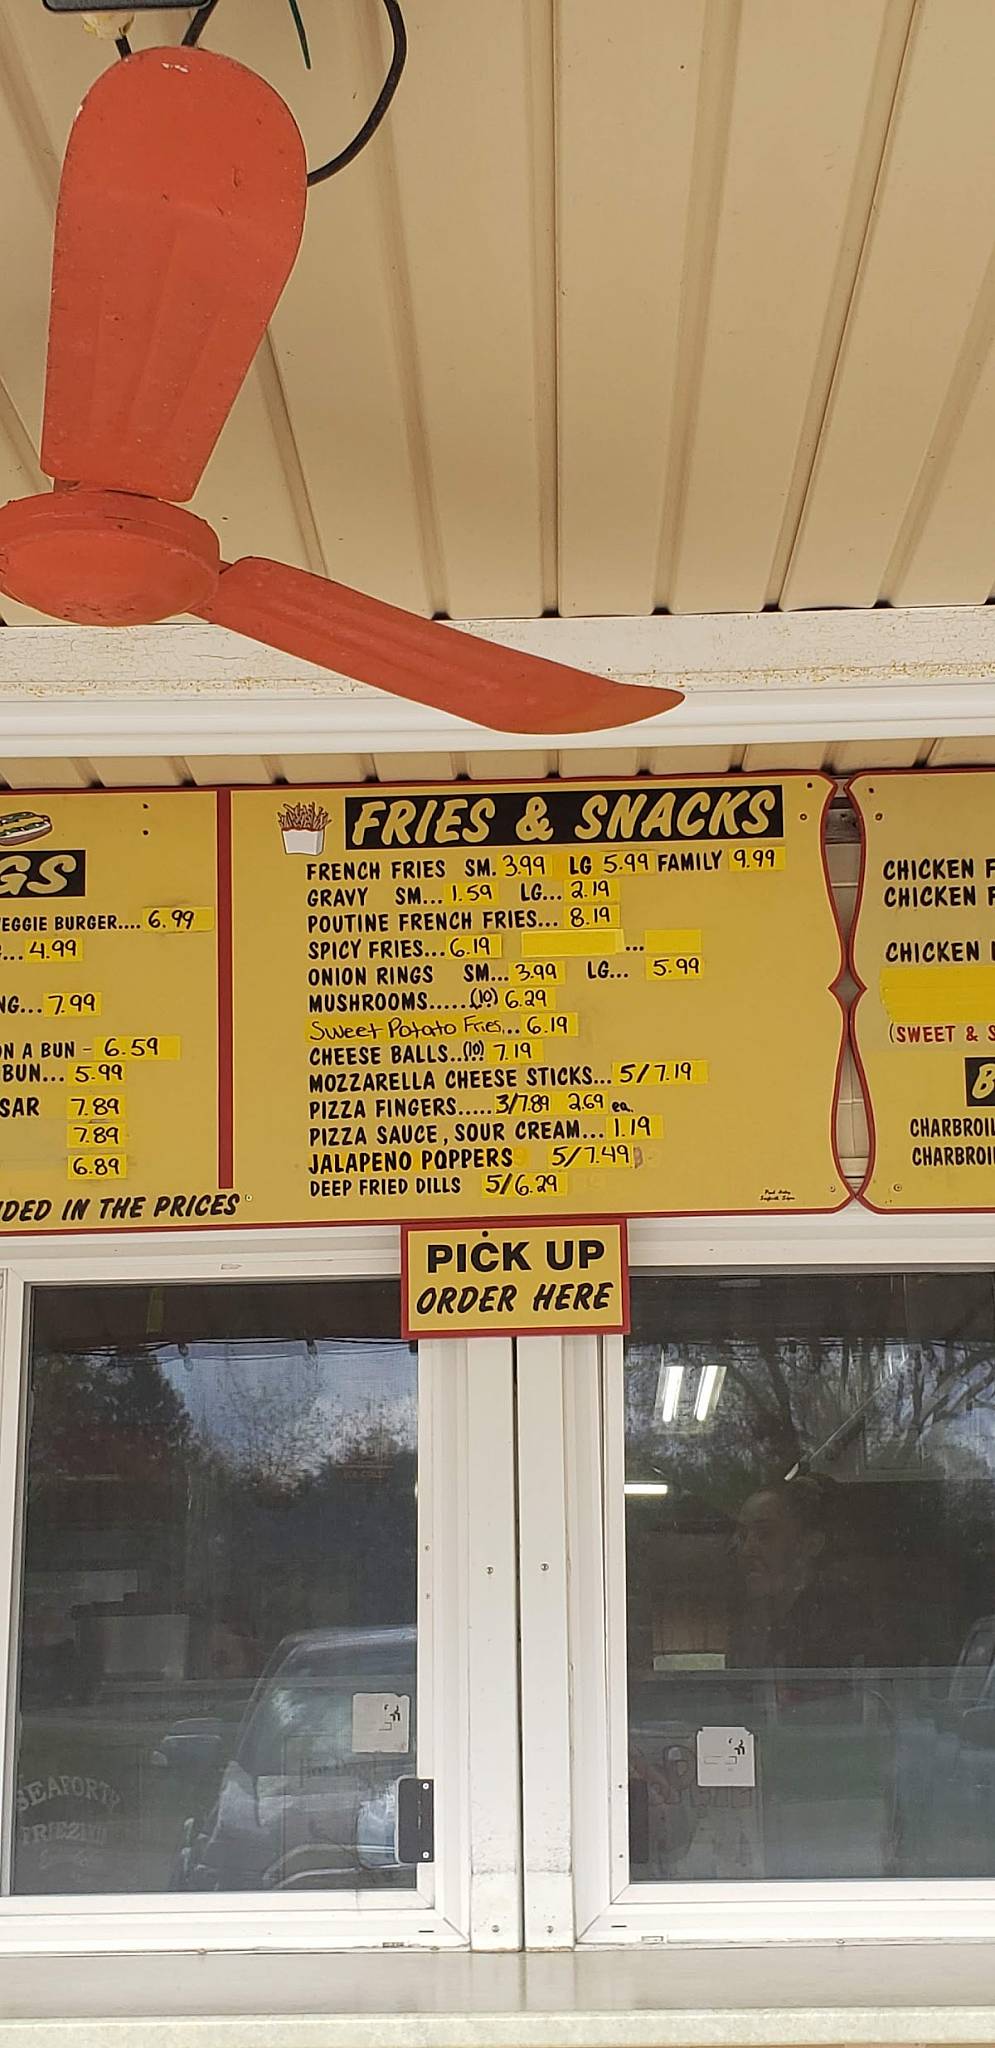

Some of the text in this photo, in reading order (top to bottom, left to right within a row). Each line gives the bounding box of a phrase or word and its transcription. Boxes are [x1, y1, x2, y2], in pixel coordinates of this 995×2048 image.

[352, 789, 775, 845] FRIES & SNACKS
[307, 850, 774, 880] FRENCH FRIES SM. 3.99 LG 5.99 FAMILY 9.99
[883, 858, 973, 880] CHICKEN
[307, 887, 368, 907] GRAVY
[453, 885, 492, 901] 1.59
[571, 881, 609, 898] 2.19
[884, 886, 976, 908] CHICKEN
[0, 915, 48, 932] EGGIE
[149, 910, 194, 929] 6.99
[308, 913, 388, 933] POUTINE
[399, 912, 471, 931] FRENCH
[571, 907, 610, 929] 8.19
[30, 940, 76, 959] 4.99
[308, 939, 361, 960] SPICY
[450, 937, 493, 959] 6.19
[886, 941, 979, 963] CHICKEN
[309, 967, 366, 986] ONION
[377, 965, 433, 985] RINGS
[516, 964, 556, 981] 3.99
[654, 958, 699, 976] 5.99
[48, 994, 95, 1015] 7.99
[505, 990, 546, 1008] 6.29
[309, 1021, 384, 1041] Sweet
[387, 1016, 457, 1038] Potato
[527, 1016, 567, 1034] 6.19
[889, 1022, 956, 1043] (SWEET
[965, 1025, 979, 1042] &
[0, 1041, 15, 1060] N
[22, 1043, 32, 1059] A
[41, 1041, 74, 1058] BUN
[105, 1038, 157, 1056] 6.59
[310, 1047, 381, 1066] CHEESE
[494, 1043, 531, 1061] 7.19
[75, 1064, 122, 1082] 5.99
[310, 1071, 435, 1093] MOZZARELLA
[446, 1069, 516, 1089] CHEESE
[620, 1062, 691, 1083] 5/7.19
[71, 1098, 119, 1115] 7.89
[310, 1100, 365, 1119] PIZZA
[496, 1093, 549, 1114] 3/7.89
[568, 1093, 603, 1111] 2.69
[74, 1127, 118, 1144] 7.89
[310, 1127, 366, 1146] PIZZA
[455, 1123, 504, 1142] SOUR
[615, 1116, 650, 1137] 1.19
[73, 1158, 119, 1175] 6.89
[307, 1145, 629, 1175] JALAPENO POPPERS 5/7.49
[311, 1173, 557, 1196] DEEP FRIED DILLS 5/6.29
[0, 1194, 240, 1222] DED IN THE PRICES
[428, 1240, 604, 1273] PICK UP
[417, 1282, 613, 1314] ORDER HERE
